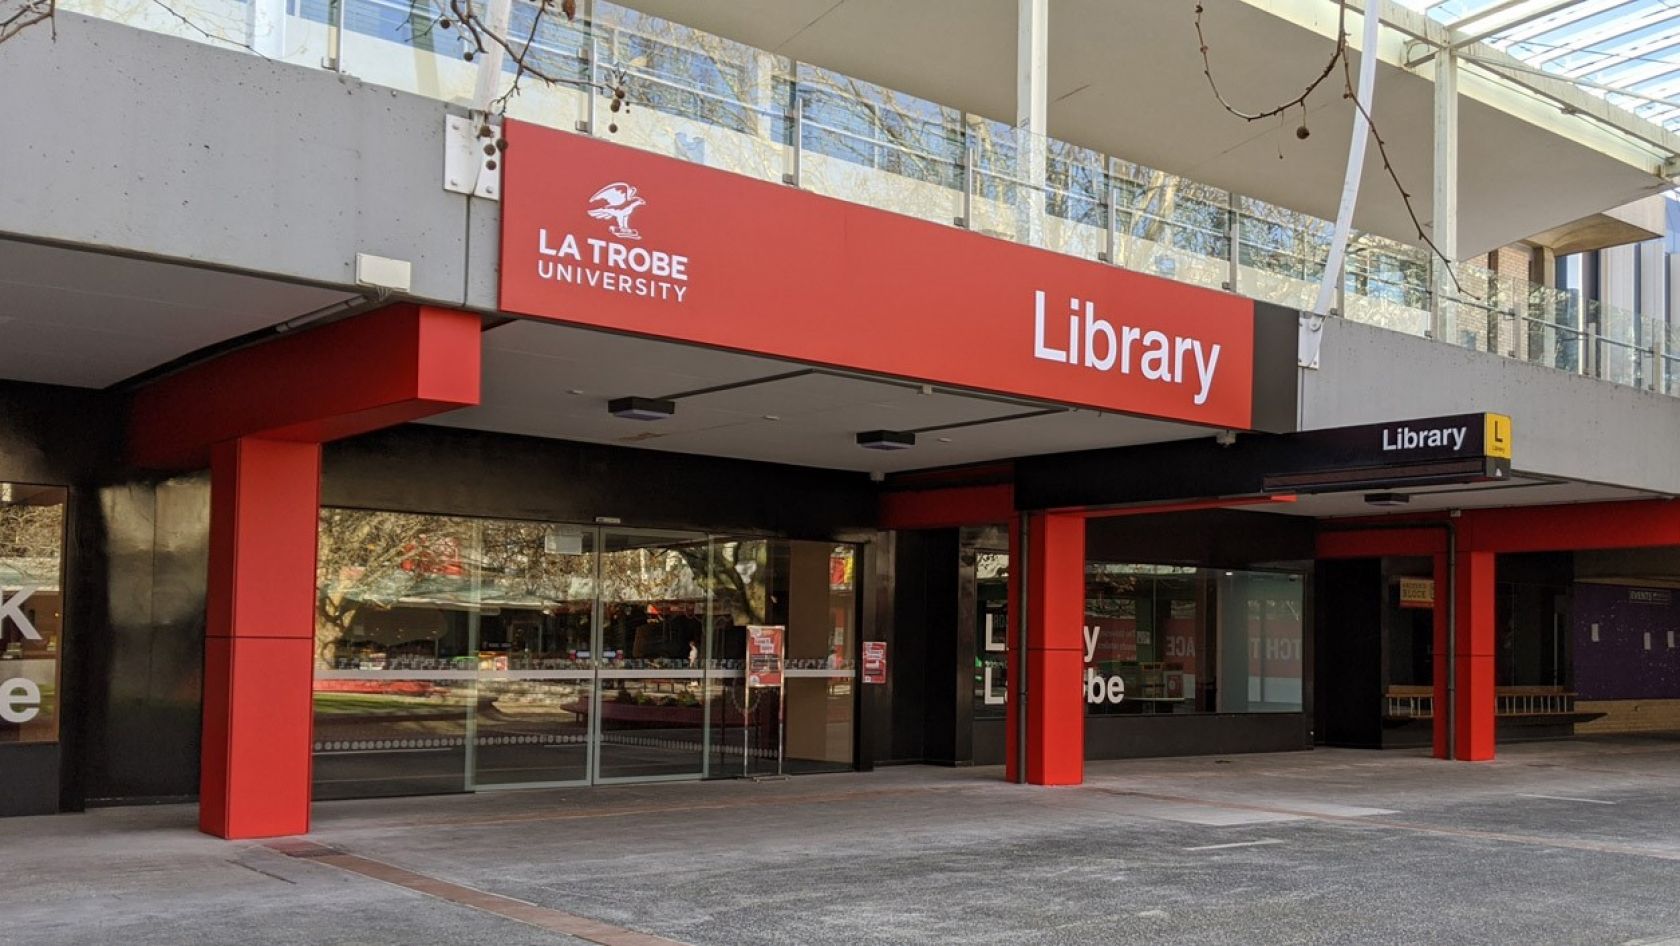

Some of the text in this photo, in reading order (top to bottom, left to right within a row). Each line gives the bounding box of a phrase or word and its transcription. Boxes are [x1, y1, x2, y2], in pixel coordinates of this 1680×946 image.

[539, 228, 688, 280] LA TROBE
[537, 259, 687, 302] UNIVERSITY
[1034, 290, 1221, 405] Library
[1382, 427, 1467, 450] Library
[1494, 420, 1503, 443] L
